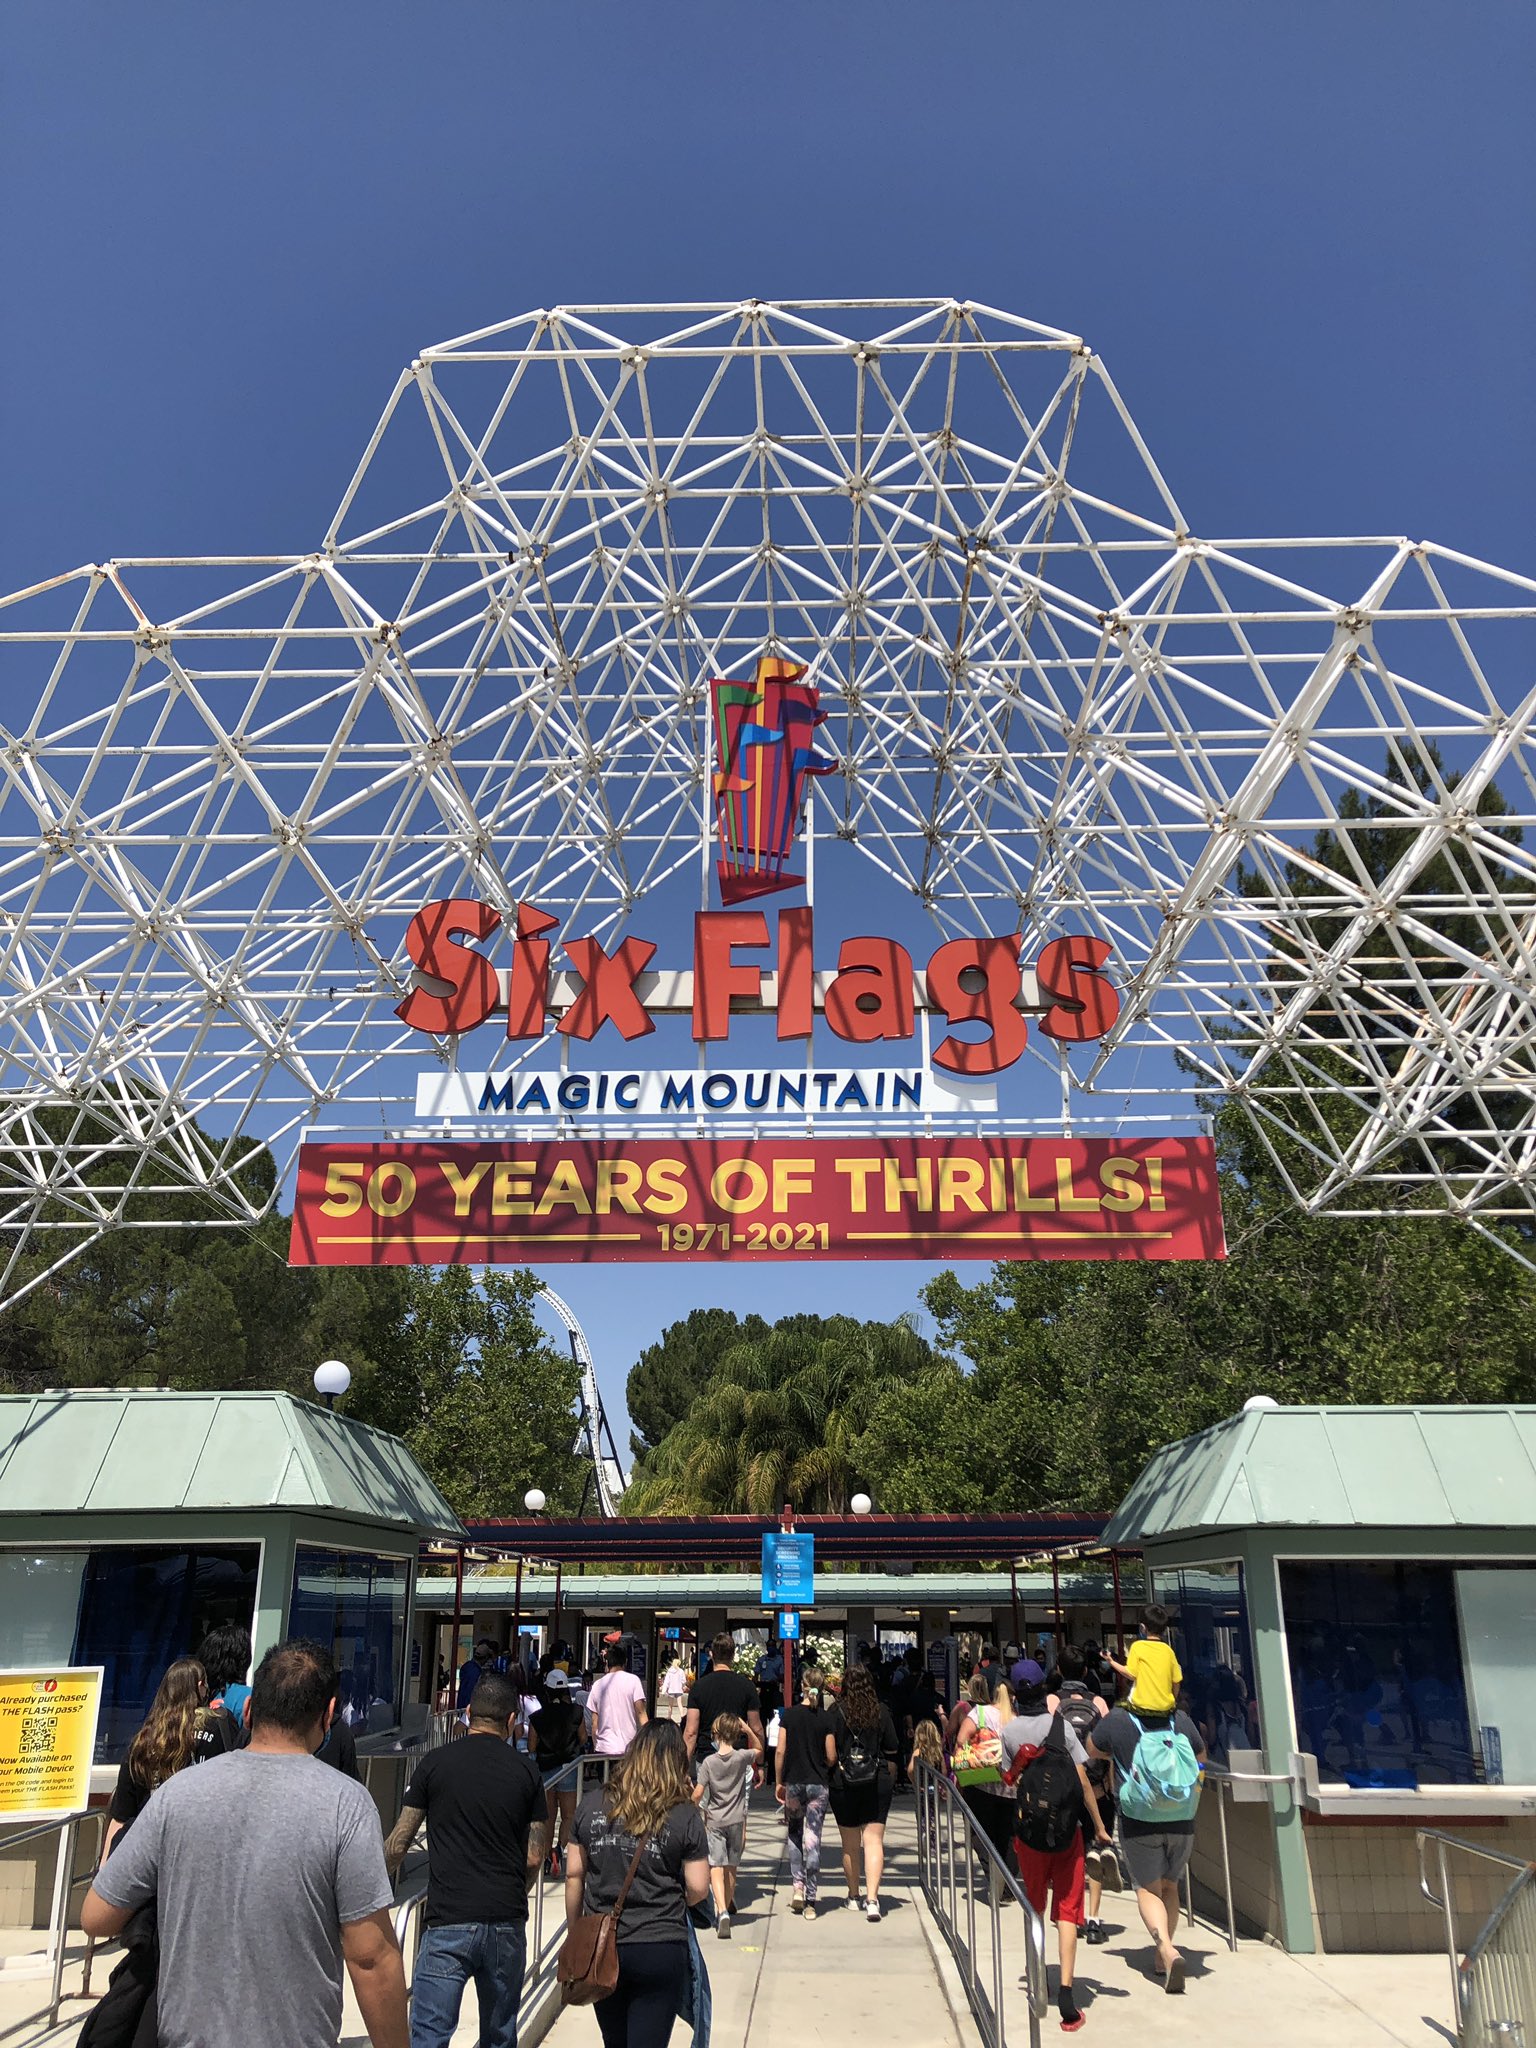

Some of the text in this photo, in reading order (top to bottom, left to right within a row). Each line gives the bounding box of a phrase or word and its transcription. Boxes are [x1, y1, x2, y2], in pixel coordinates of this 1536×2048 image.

[393, 898, 1120, 1076] Six Flags
[478, 1072, 923, 1111] MAGIC MOUNTAIN
[318, 1156, 1167, 1218] 50 YEARS OF THRILLS!
[656, 1221, 830, 1252] 1971-2021
[0, 1693, 88, 1705] Already purchased
[2, 1705, 83, 1716] THE FLASH pass?
[14, 1766, 44, 1775] Mobile
[45, 1764, 75, 1773] Device
[19, 1754, 60, 1764] Available
[60, 1754, 72, 1762] on
